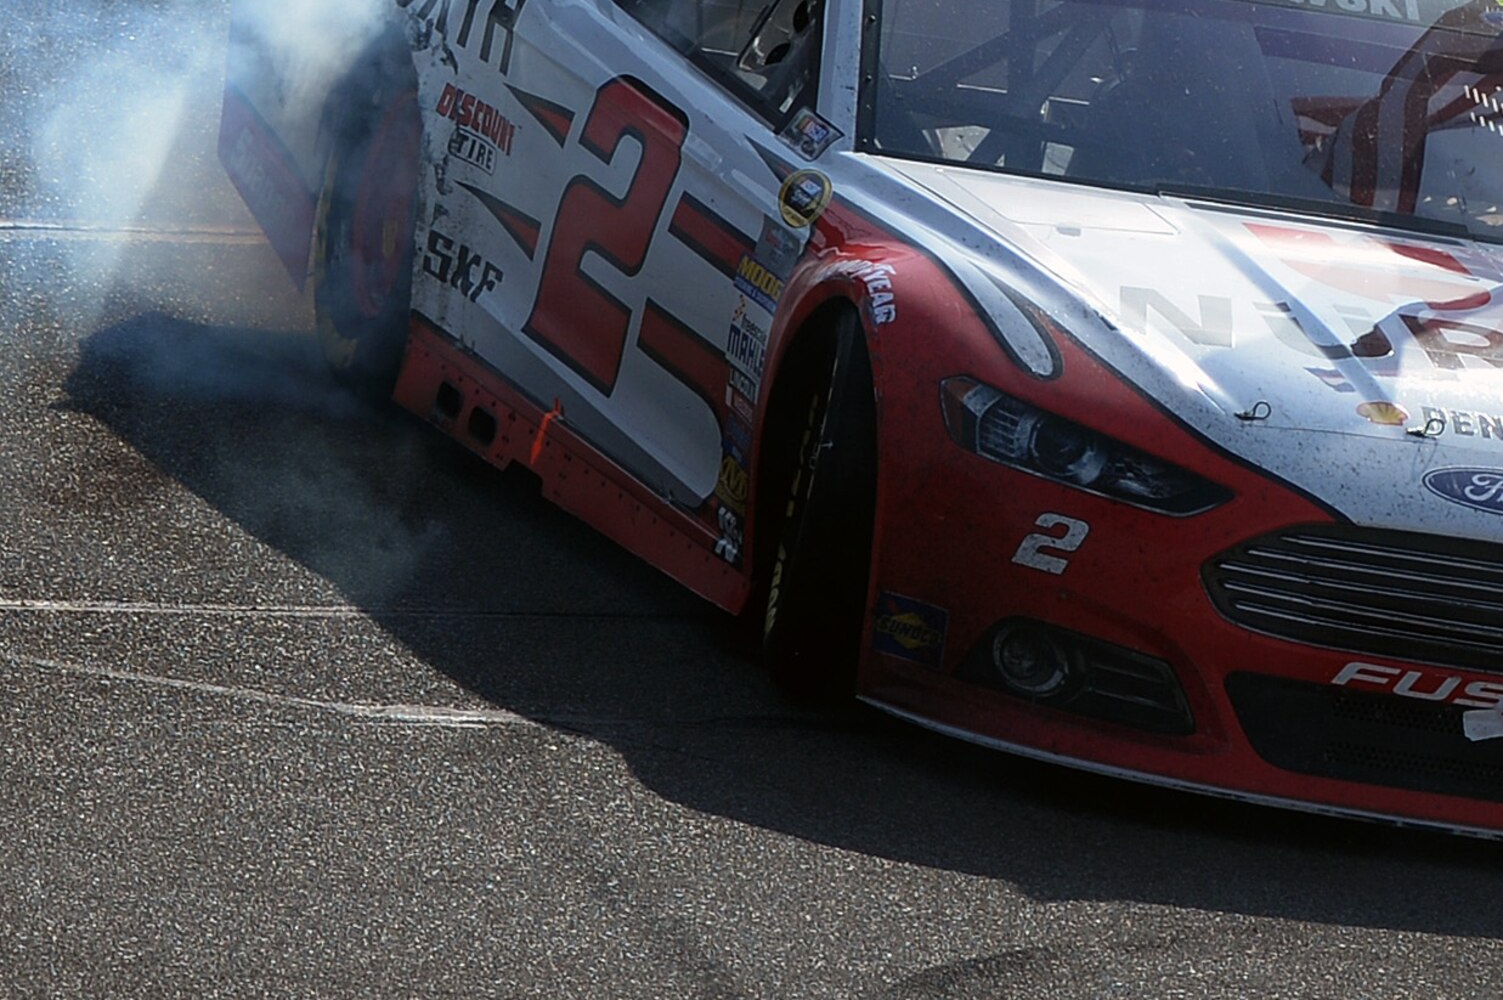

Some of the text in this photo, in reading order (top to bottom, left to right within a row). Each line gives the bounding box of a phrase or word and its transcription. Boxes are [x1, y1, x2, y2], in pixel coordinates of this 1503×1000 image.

[435, 82, 515, 157] DISCOUNT
[422, 230, 504, 303] SKF
[521, 73, 691, 399] 2
[738, 254, 787, 301] MOOG
[1010, 511, 1090, 575] 2
